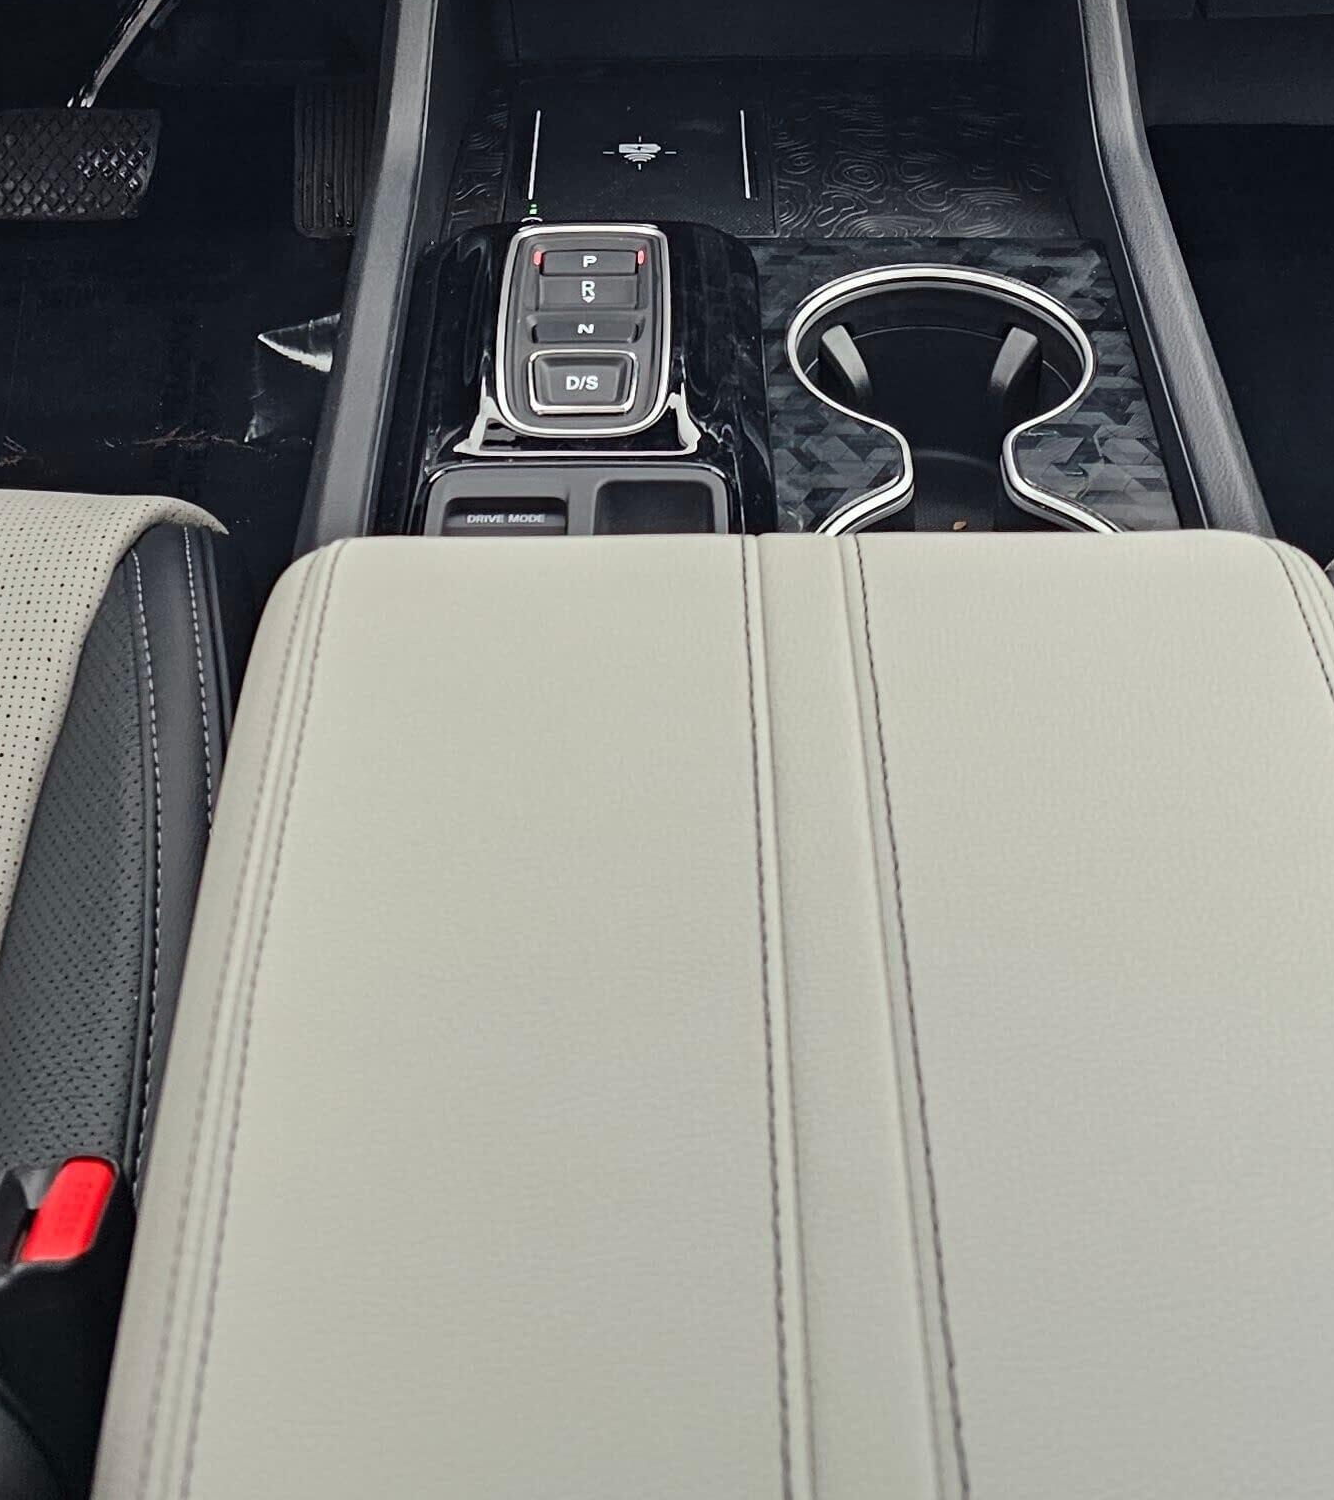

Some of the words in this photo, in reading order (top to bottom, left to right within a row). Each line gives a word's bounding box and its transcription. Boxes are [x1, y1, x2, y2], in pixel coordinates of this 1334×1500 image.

[583, 255, 597, 267] P
[581, 280, 595, 298] R
[578, 324, 595, 334] N
[566, 376, 599, 390] D/S
[467, 514, 504, 524] DRIVE
[507, 513, 545, 524] MODE
